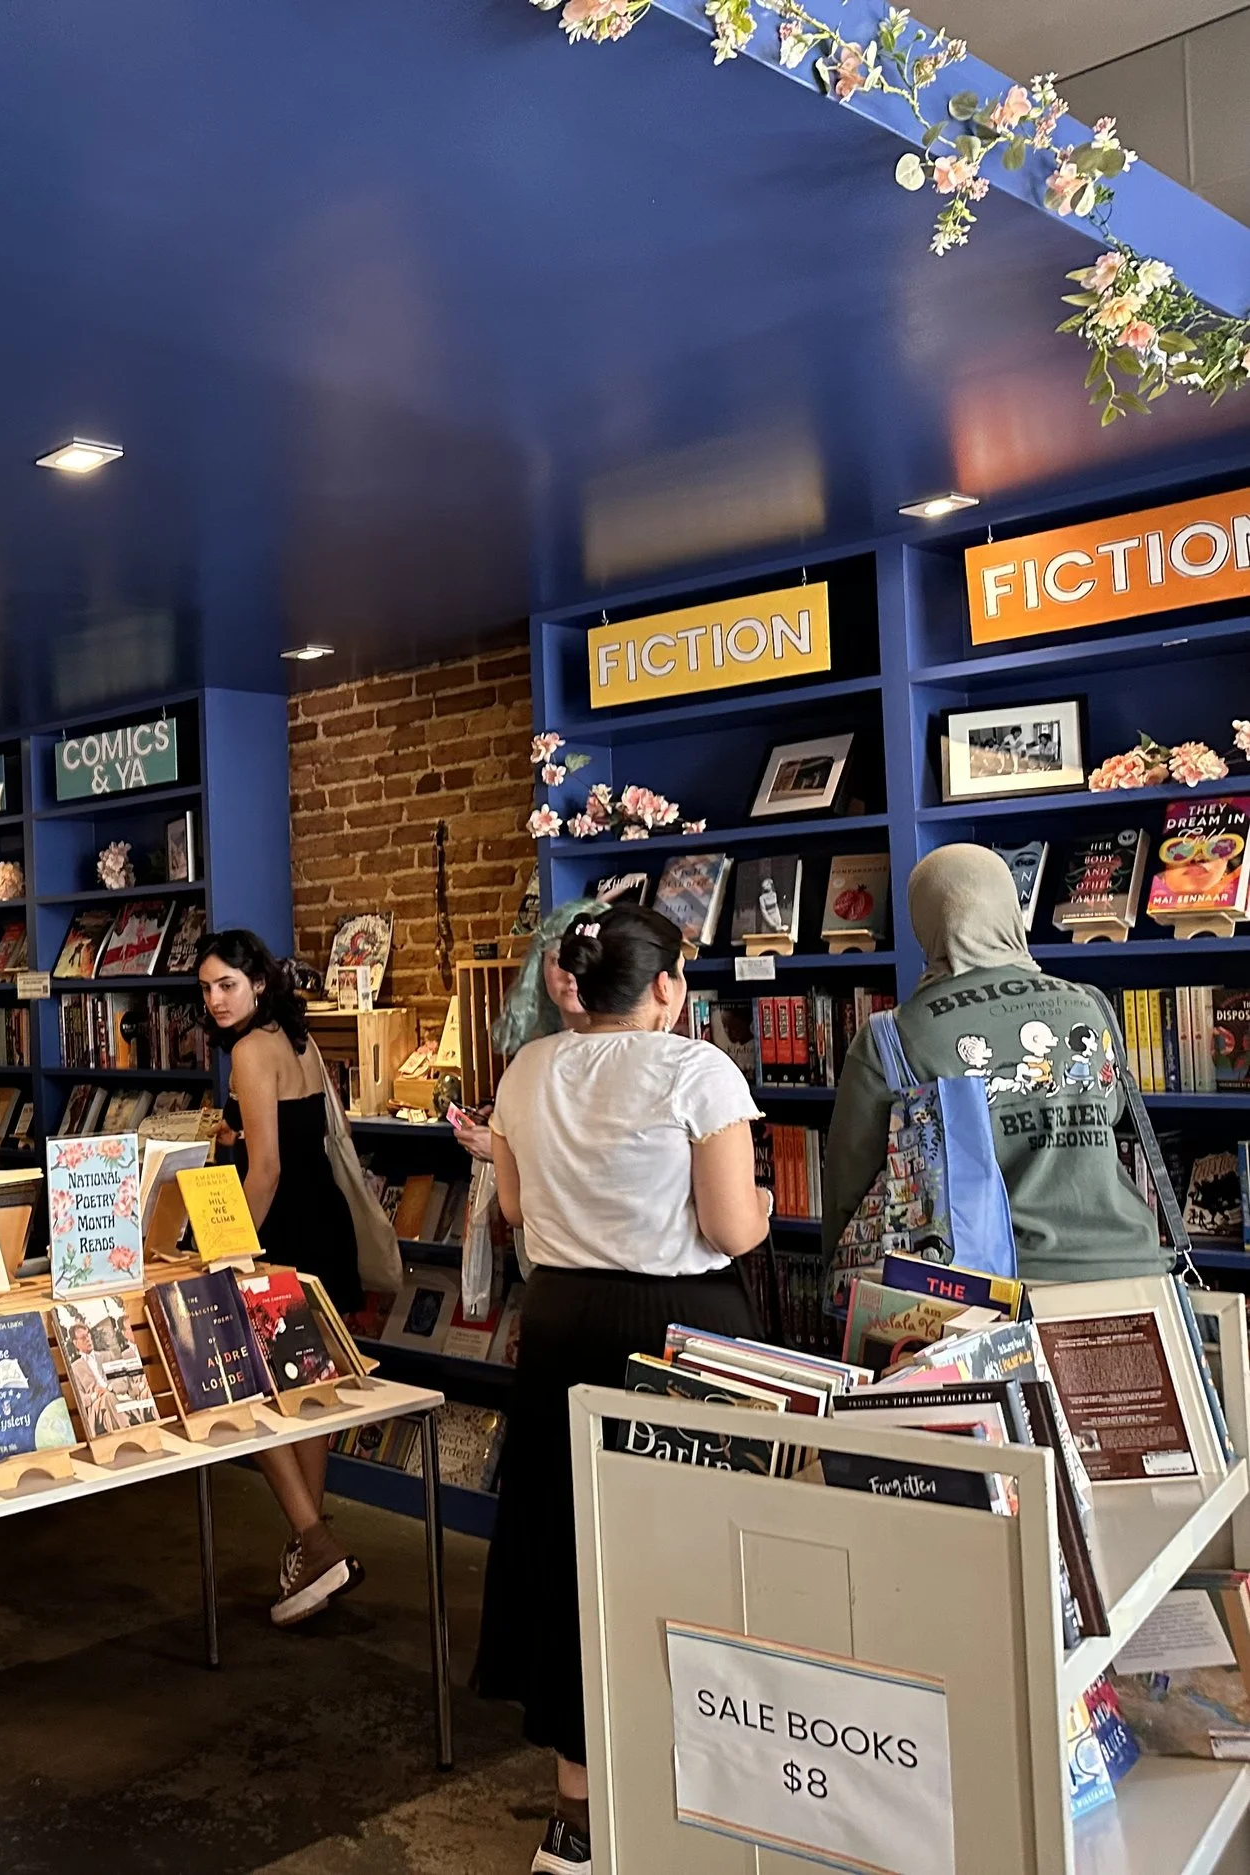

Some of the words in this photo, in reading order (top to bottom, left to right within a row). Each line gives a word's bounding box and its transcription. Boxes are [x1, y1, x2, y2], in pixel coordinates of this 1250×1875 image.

[597, 609, 812, 688] FICTION
[62, 720, 170, 770] COMICS
[91, 766, 111, 795] &
[115, 758, 148, 790] YA
[1189, 803, 1227, 816] THEY
[1166, 815, 1221, 830] DREAM
[1227, 813, 1246, 825] IN
[1090, 841, 1112, 851] HER
[1084, 854, 1114, 864] BODY
[1084, 868, 1109, 877] AND
[1076, 881, 1113, 891] OTHER
[1153, 896, 1172, 905] MAI
[1177, 893, 1228, 904] SENNAAR
[1039, 1103, 1108, 1131] FRIEN
[68, 1170, 121, 1189] NATIONAL
[75, 1193, 116, 1211] POETRY
[213, 1206, 228, 1215] WE
[77, 1214, 115, 1232] MONTH
[210, 1214, 236, 1225] CLIMB
[79, 1236, 115, 1254] READS
[926, 1276, 967, 1300] THE
[916, 1302, 920, 1313] I
[923, 1307, 942, 1318] am
[867, 1312, 916, 1332] Malala
[207, 1346, 249, 1368] AUDRE
[893, 1397, 910, 1406] THE
[912, 1393, 973, 1405] IMMORTALITY
[975, 1391, 993, 1401] KEY
[625, 1420, 750, 1474] Darlin
[697, 1689, 775, 1734] SALE
[787, 1711, 918, 1769] BOOKS
[783, 1759, 828, 1799] $8
